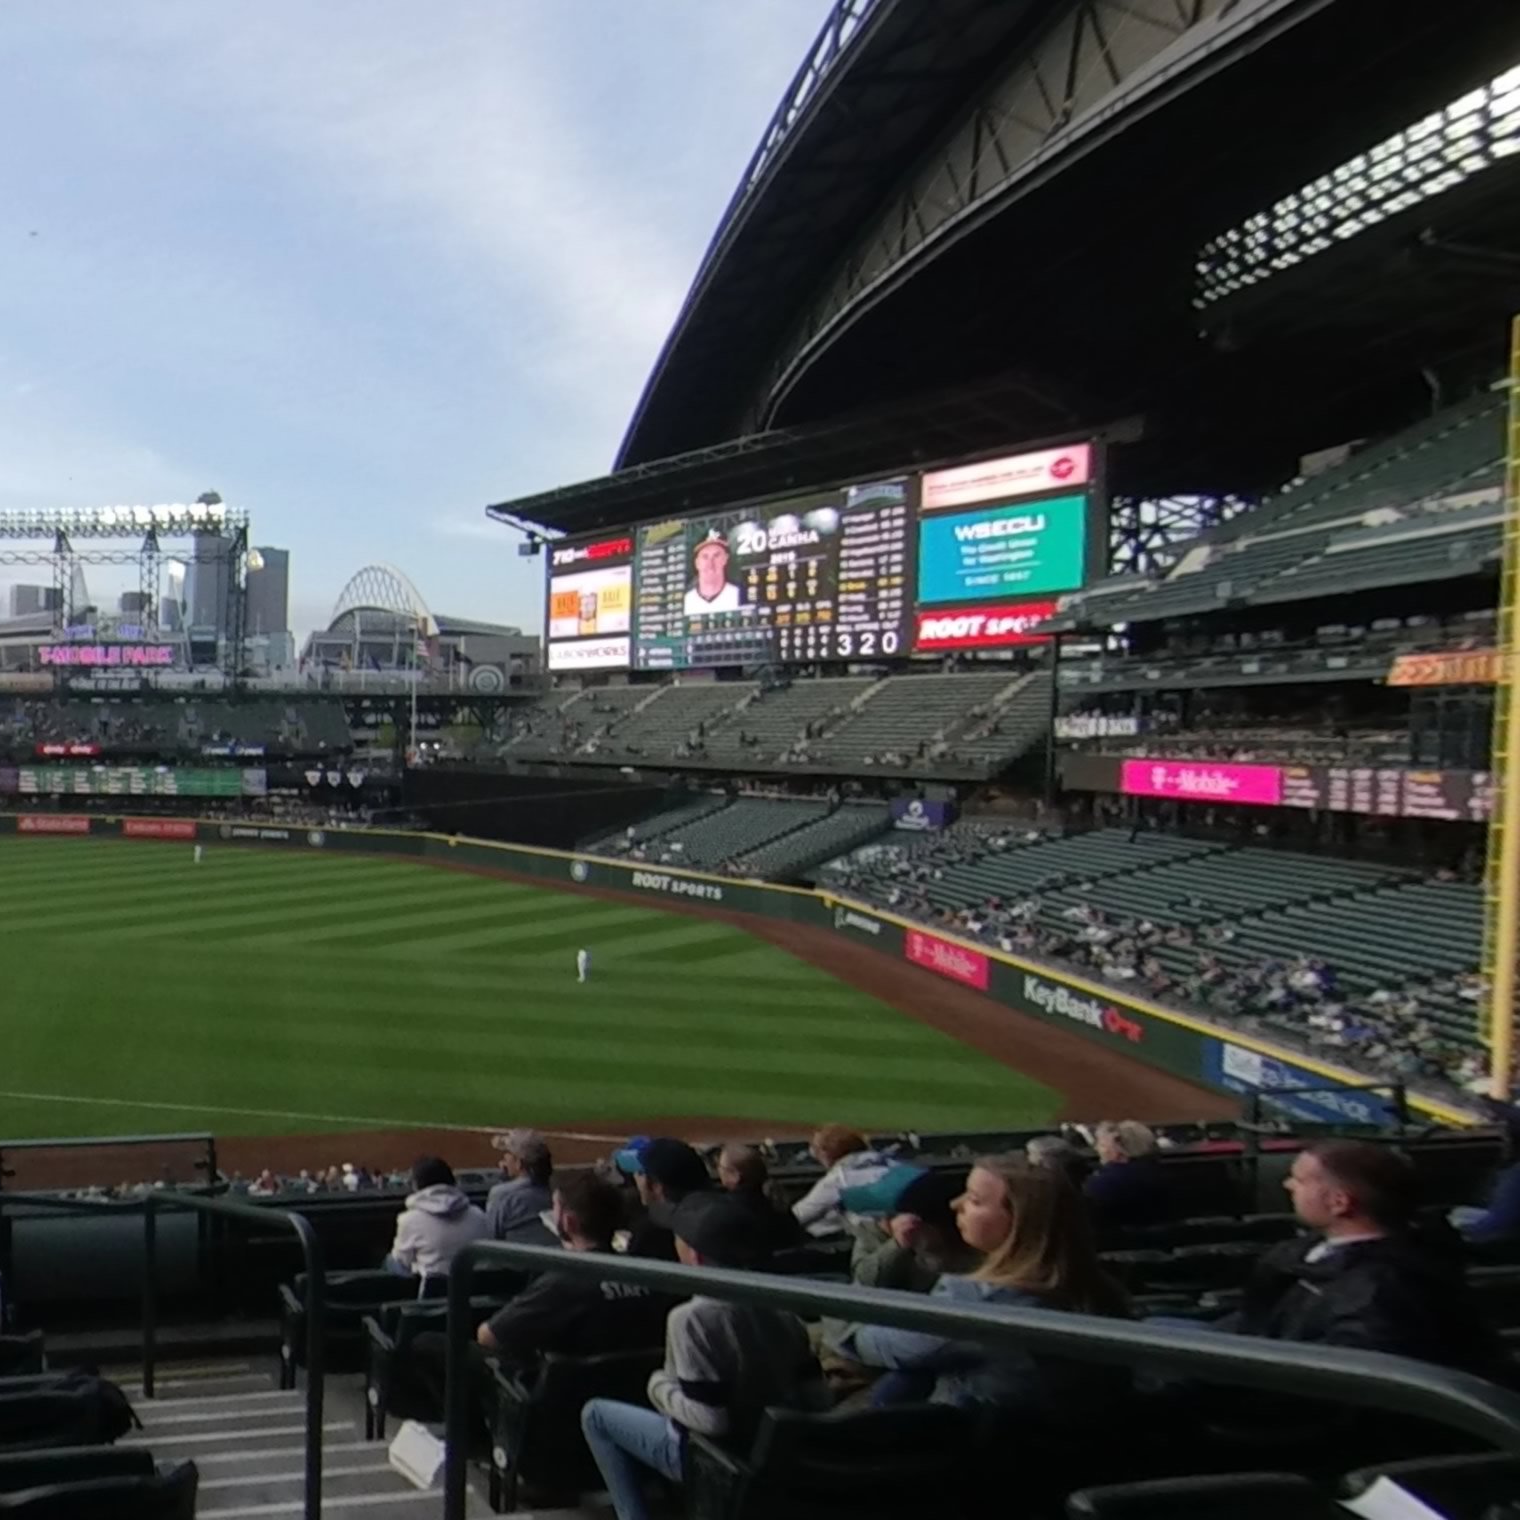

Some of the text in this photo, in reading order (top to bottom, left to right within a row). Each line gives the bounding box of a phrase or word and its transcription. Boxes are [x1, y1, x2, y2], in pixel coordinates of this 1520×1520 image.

[736, 530, 766, 555] 20
[768, 529, 821, 549] CANHA
[919, 615, 987, 641] ROOT
[38, 645, 172, 664] T-MOBILE PARK
[837, 631, 898, 656] 3 2 0
[632, 871, 723, 900] ROOT SPORTS
[1023, 974, 1104, 1030] KeyBank
